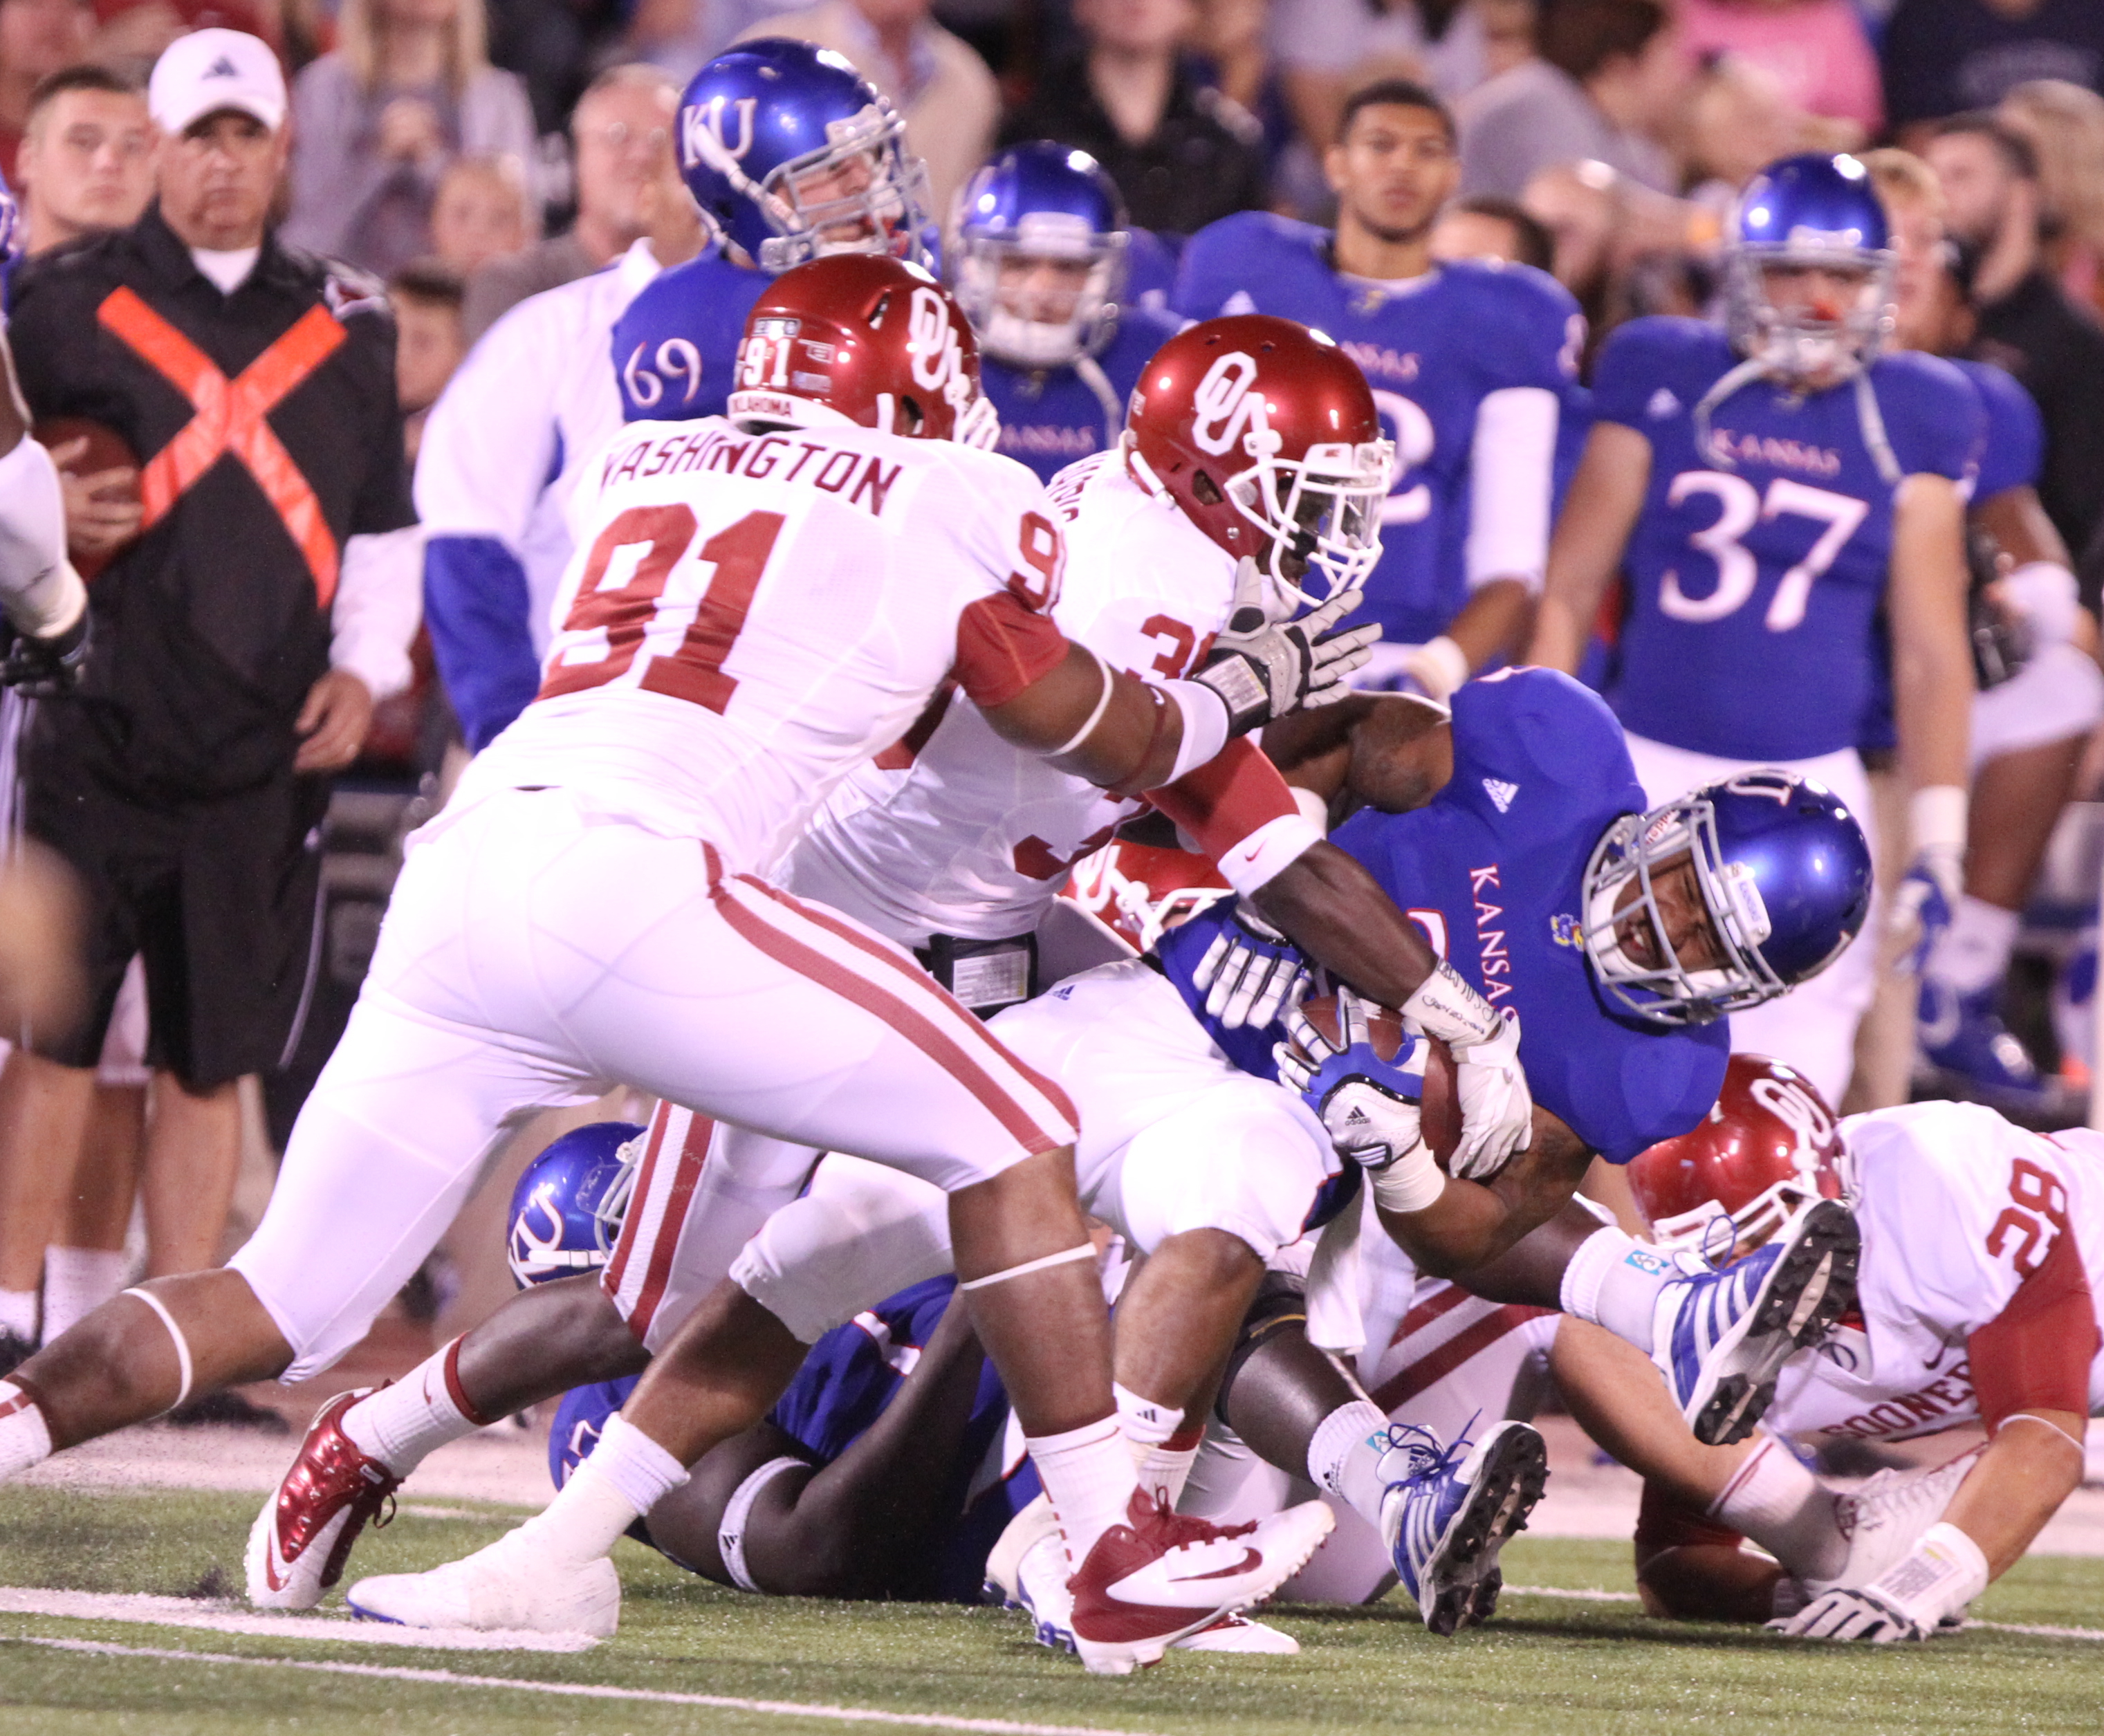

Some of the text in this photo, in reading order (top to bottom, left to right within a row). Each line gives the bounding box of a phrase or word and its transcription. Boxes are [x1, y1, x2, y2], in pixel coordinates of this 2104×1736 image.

[681, 95, 758, 167] KU
[623, 338, 702, 408] 69
[742, 337, 792, 387] 91
[1340, 340, 1420, 384] NSAS
[1001, 423, 1096, 453] ANSAS
[1712, 427, 1842, 477] KANSAS
[1658, 470, 1870, 632] 37
[532, 501, 788, 717] 91
[1345, 1117, 1372, 1127] adidas
[1749, 1078, 1833, 1147] OU
[1986, 1157, 2068, 1278] 28
